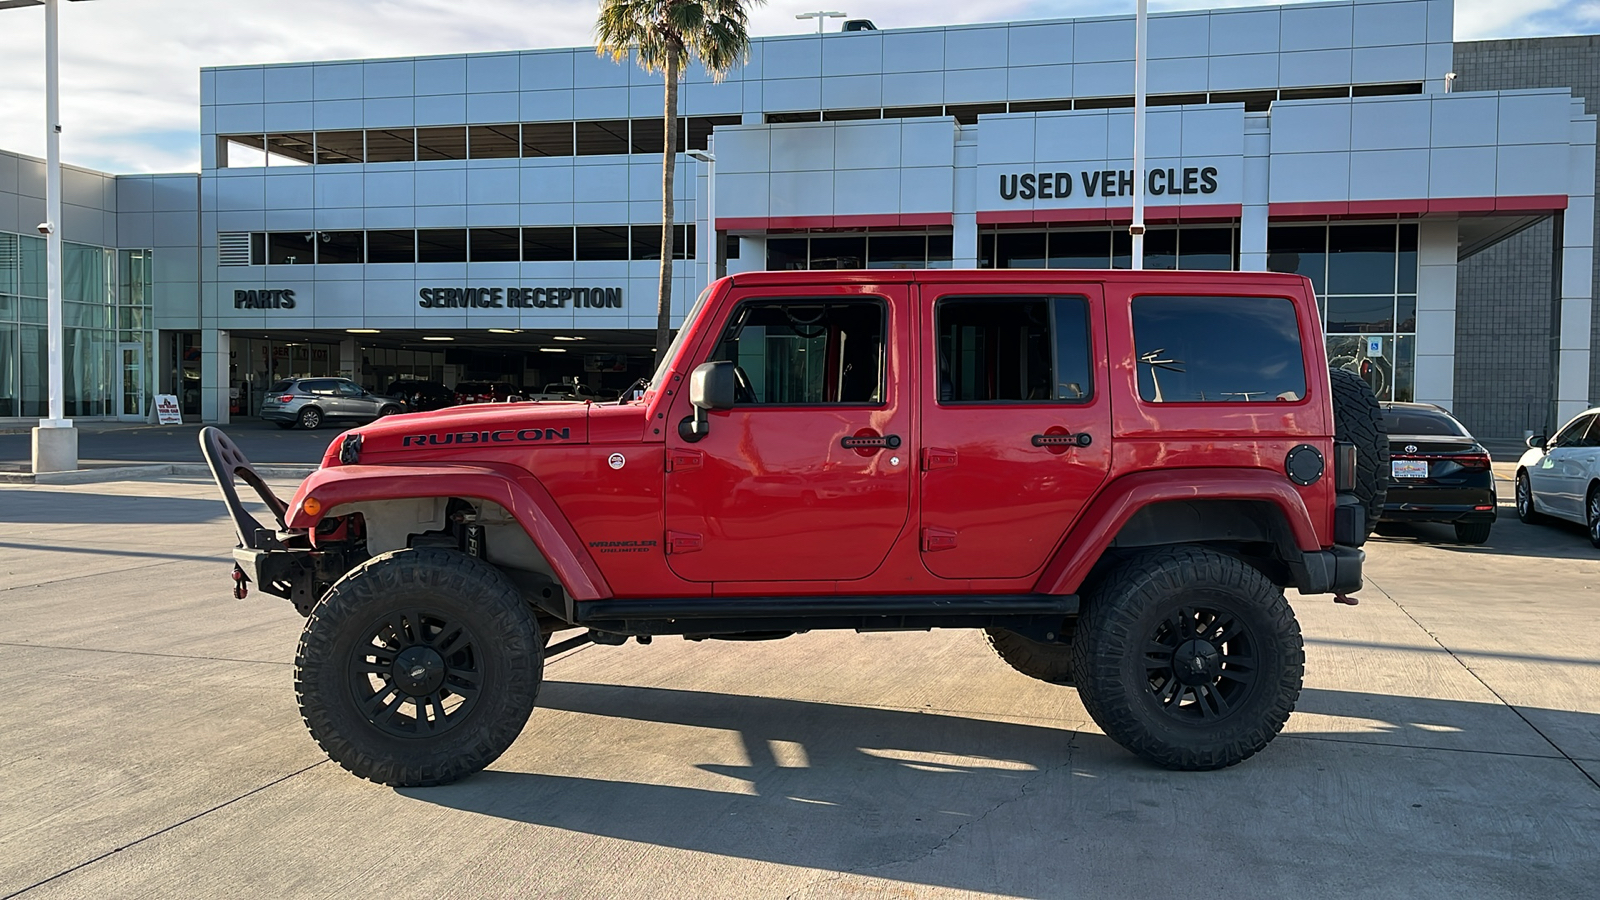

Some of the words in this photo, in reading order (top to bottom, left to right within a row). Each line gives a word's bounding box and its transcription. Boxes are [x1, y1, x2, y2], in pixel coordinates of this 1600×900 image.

[1000, 173, 1072, 200] USED
[1081, 167, 1218, 198] VEHCLES
[234, 289, 296, 309] PARTS
[419, 287, 503, 309] SERVICE
[507, 287, 622, 309] RECEPTION
[262, 346, 294, 356] DSER
[402, 427, 570, 447] RUBICON
